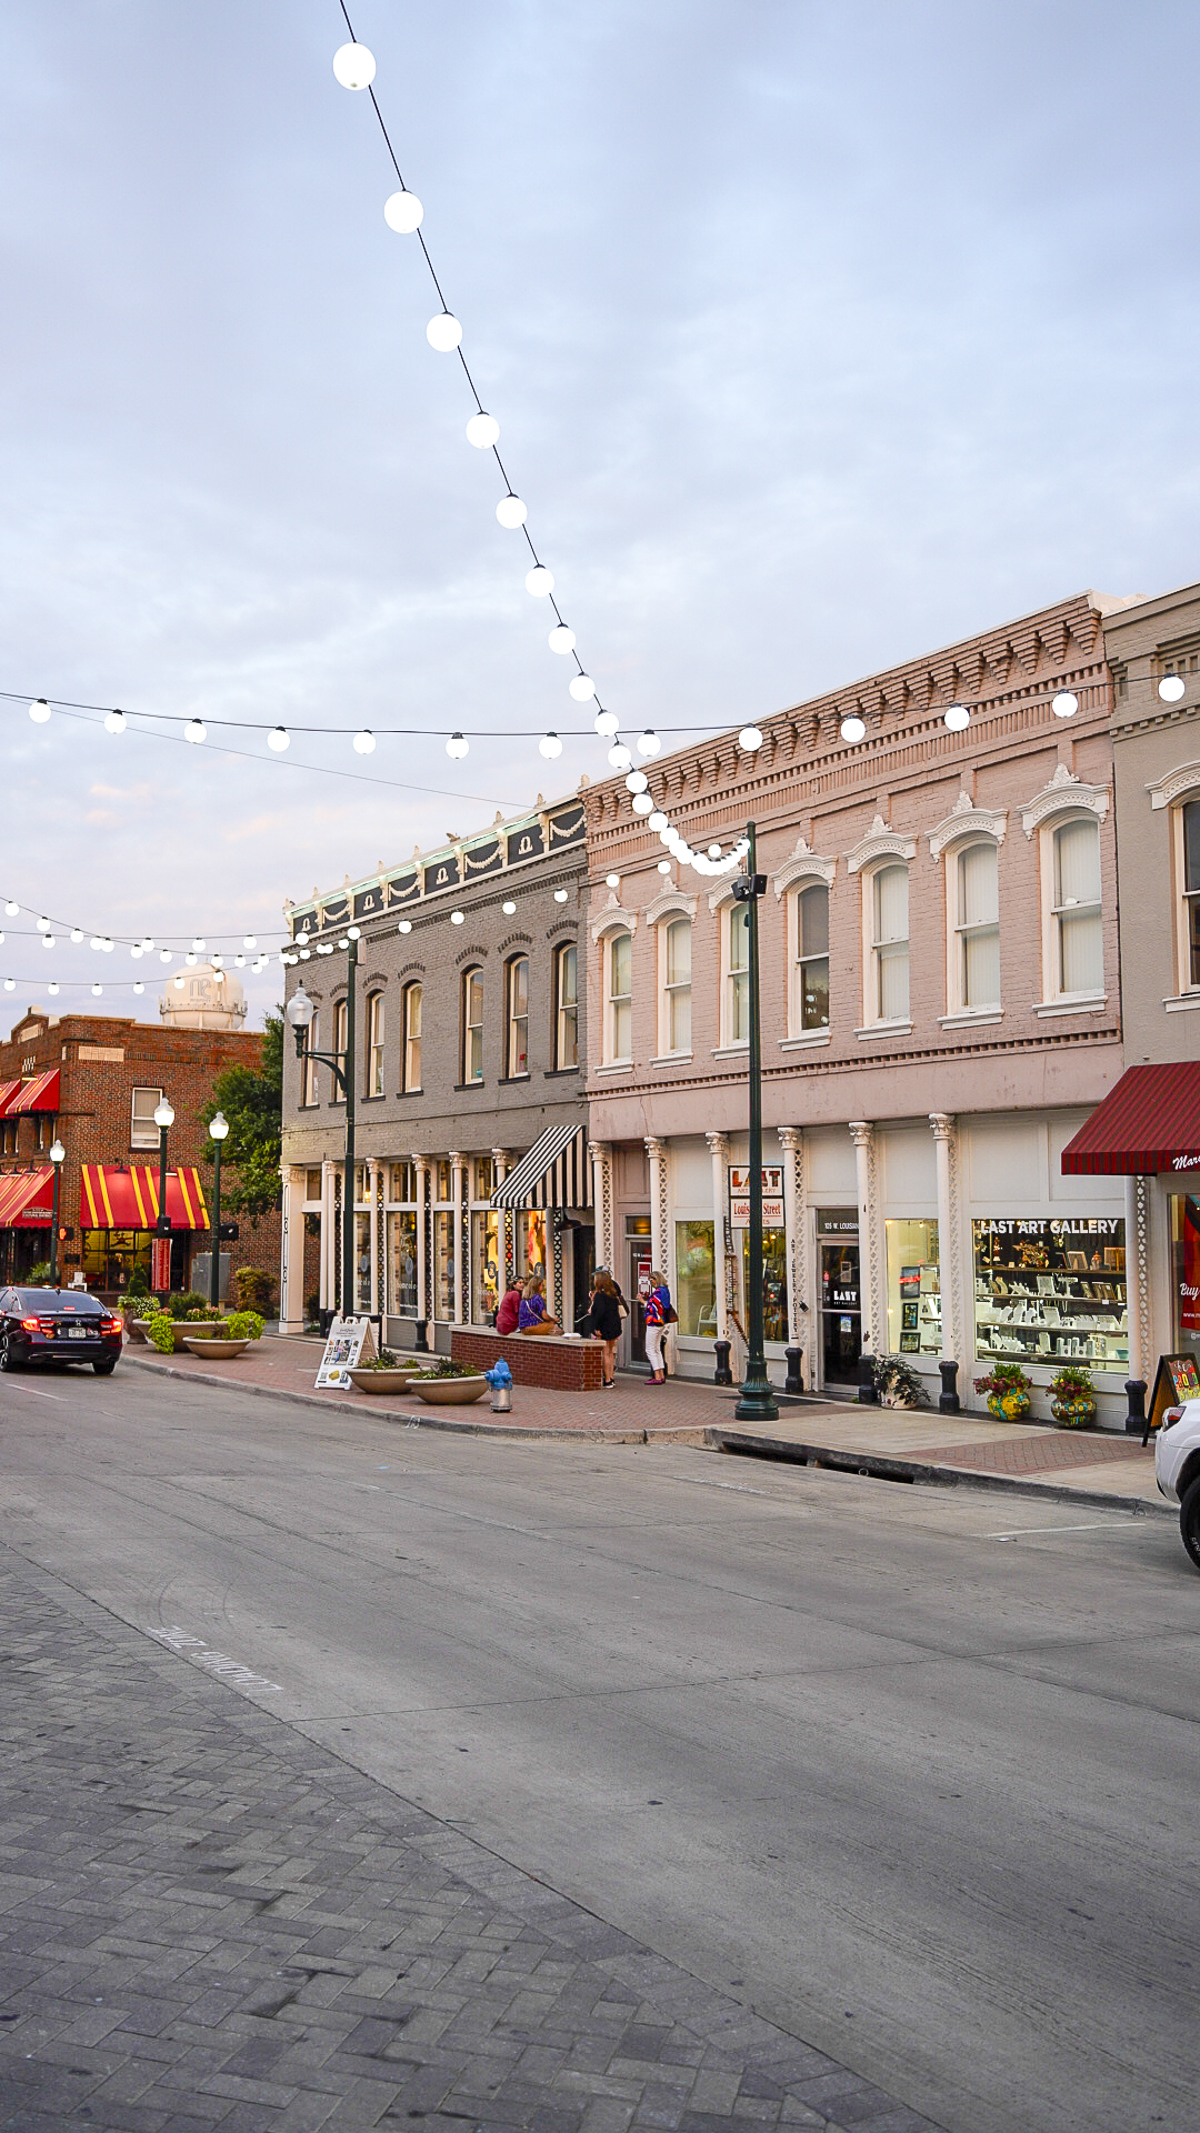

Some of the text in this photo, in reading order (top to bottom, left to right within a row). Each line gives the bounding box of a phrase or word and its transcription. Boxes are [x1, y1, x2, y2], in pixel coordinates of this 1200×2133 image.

[762, 1202, 781, 1215] Street
[981, 1219, 1118, 1234] LAST ART GALLERY
[833, 1290, 857, 1302] LAST
[1180, 1282, 1199, 1301] Buy
